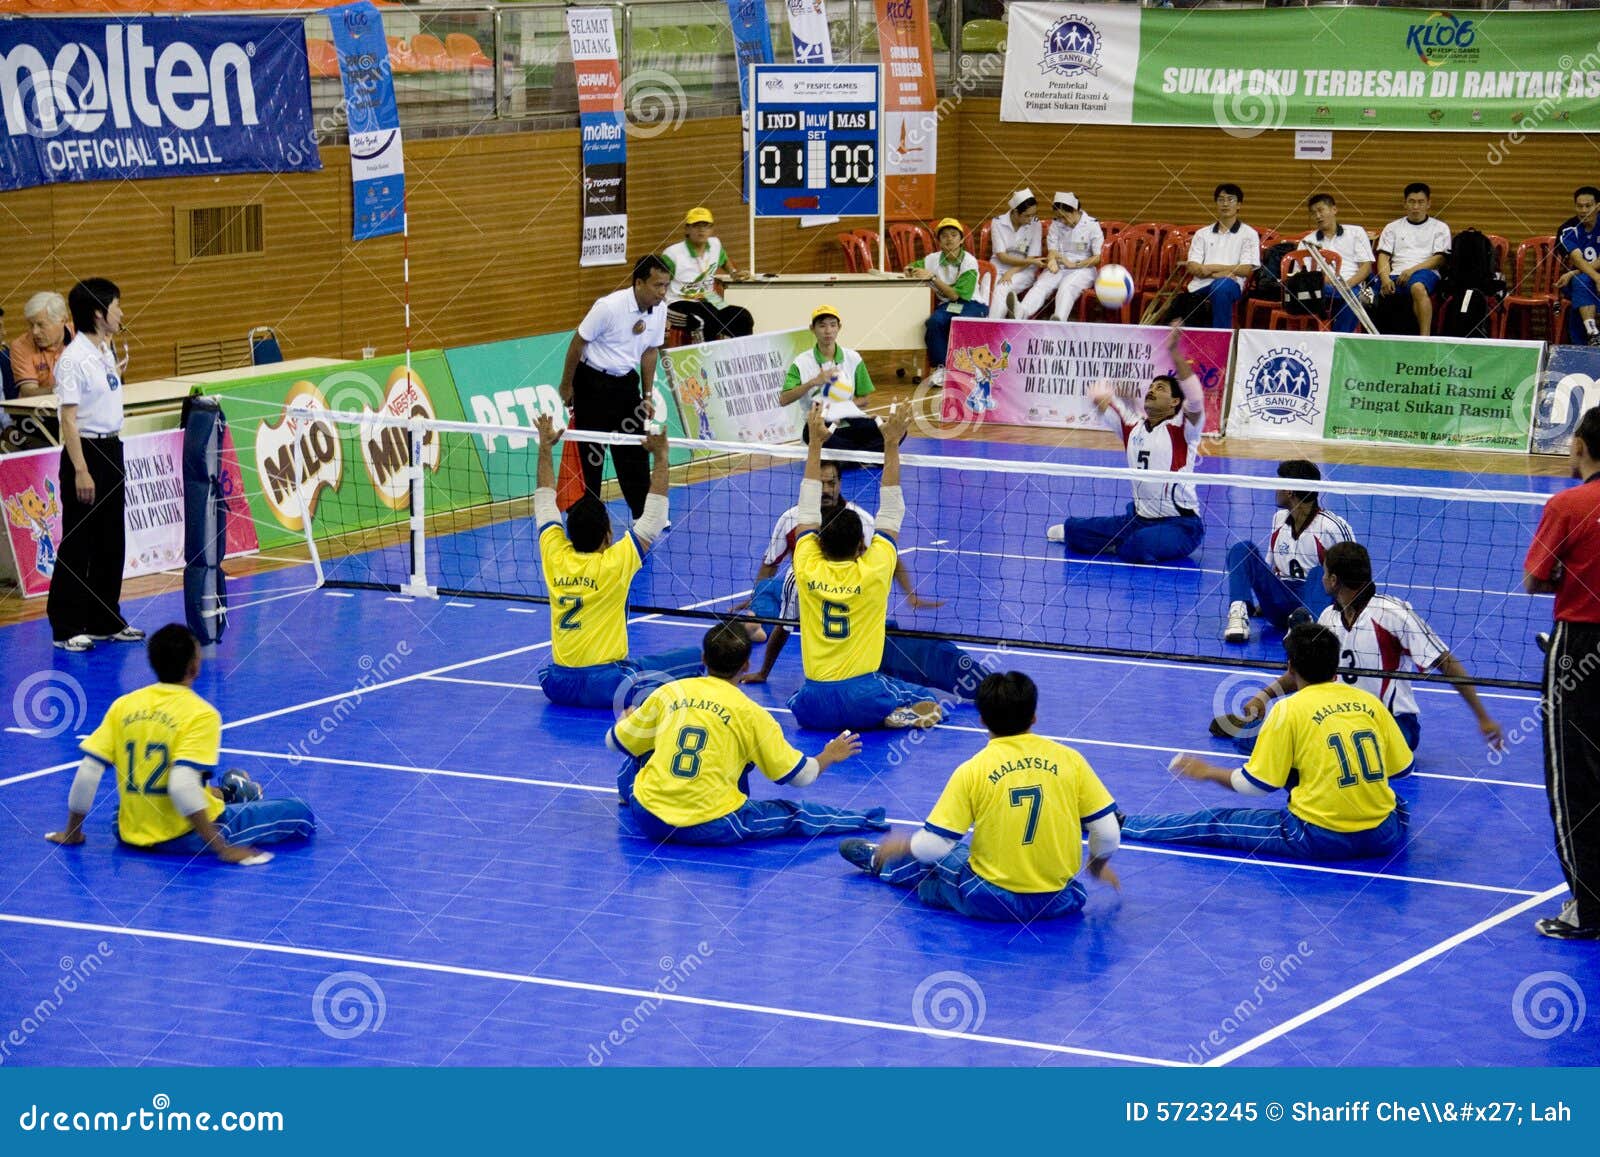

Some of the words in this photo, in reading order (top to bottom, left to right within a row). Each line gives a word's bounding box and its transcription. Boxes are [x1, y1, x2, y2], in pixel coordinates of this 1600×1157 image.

[571, 19, 608, 34] SELAMAT
[573, 39, 611, 54] DATANG
[1059, 54, 1083, 63] SANYU
[1048, 81, 1088, 90] Pembekal
[1162, 66, 1242, 95] SUKAN
[1247, 68, 1298, 96] OKU
[1303, 69, 1426, 97] TERBESAR
[1430, 71, 1458, 98] DI
[1462, 71, 1562, 98] RANTAU
[1024, 91, 1073, 100] Cenderahati
[1075, 93, 1100, 101] Rasmi
[1102, 93, 1110, 101] &
[1026, 102, 1052, 111] Pingat
[1054, 102, 1080, 111] Sukan
[1081, 103, 1107, 111] Rasmi
[583, 122, 621, 141] molten
[767, 114, 797, 129] IND
[806, 114, 828, 127] MLW
[837, 114, 866, 128] MAS
[807, 131, 826, 140] SET
[48, 138, 157, 171] OFFICIAL
[158, 136, 223, 165] BALL
[760, 145, 803, 184] 01
[831, 144, 874, 183] 00
[593, 178, 622, 188] TOPPER
[584, 227, 597, 240] ASIA
[599, 225, 624, 240] PACIFIC
[583, 244, 601, 256] SPORTS
[602, 245, 612, 254] SDN
[613, 243, 625, 253] BHD
[1583, 246, 1598, 265] 9
[1027, 338, 1054, 356] KL'06
[1056, 340, 1089, 358] SUKAN
[1091, 341, 1125, 359] FESPIC
[1127, 343, 1152, 361] KE-9
[1017, 358, 1049, 375] SUKAN
[1051, 359, 1071, 377] OKU
[1075, 360, 1100, 378] YANG
[1102, 361, 1155, 380] TERBESAR
[1396, 362, 1473, 379] Pembekal
[1025, 376, 1036, 393] DI
[1037, 377, 1075, 395] RANTAU
[1344, 377, 1441, 396] Cenderahati
[1446, 384, 1497, 400] Rasmi
[1501, 387, 1516, 401] &
[1265, 397, 1297, 407] SANYU
[1350, 396, 1401, 415] Pingat
[1404, 400, 1454, 416] Sukan
[1459, 404, 1512, 420] Rasmi
[153, 453, 174, 476] KE-9
[138, 477, 184, 504] TERBESAR
[128, 509, 149, 531] ASIA
[148, 502, 183, 527] PASIFIK
[558, 596, 584, 631] 2
[822, 599, 851, 640] 6
[669, 698, 732, 726] MALAYSIA
[1312, 702, 1375, 725] MALAYSIA
[670, 725, 709, 780] 8
[1327, 729, 1385, 789] 10
[125, 741, 170, 796] 12
[988, 757, 1059, 784] MALAYSIA
[1008, 784, 1044, 845] 7
